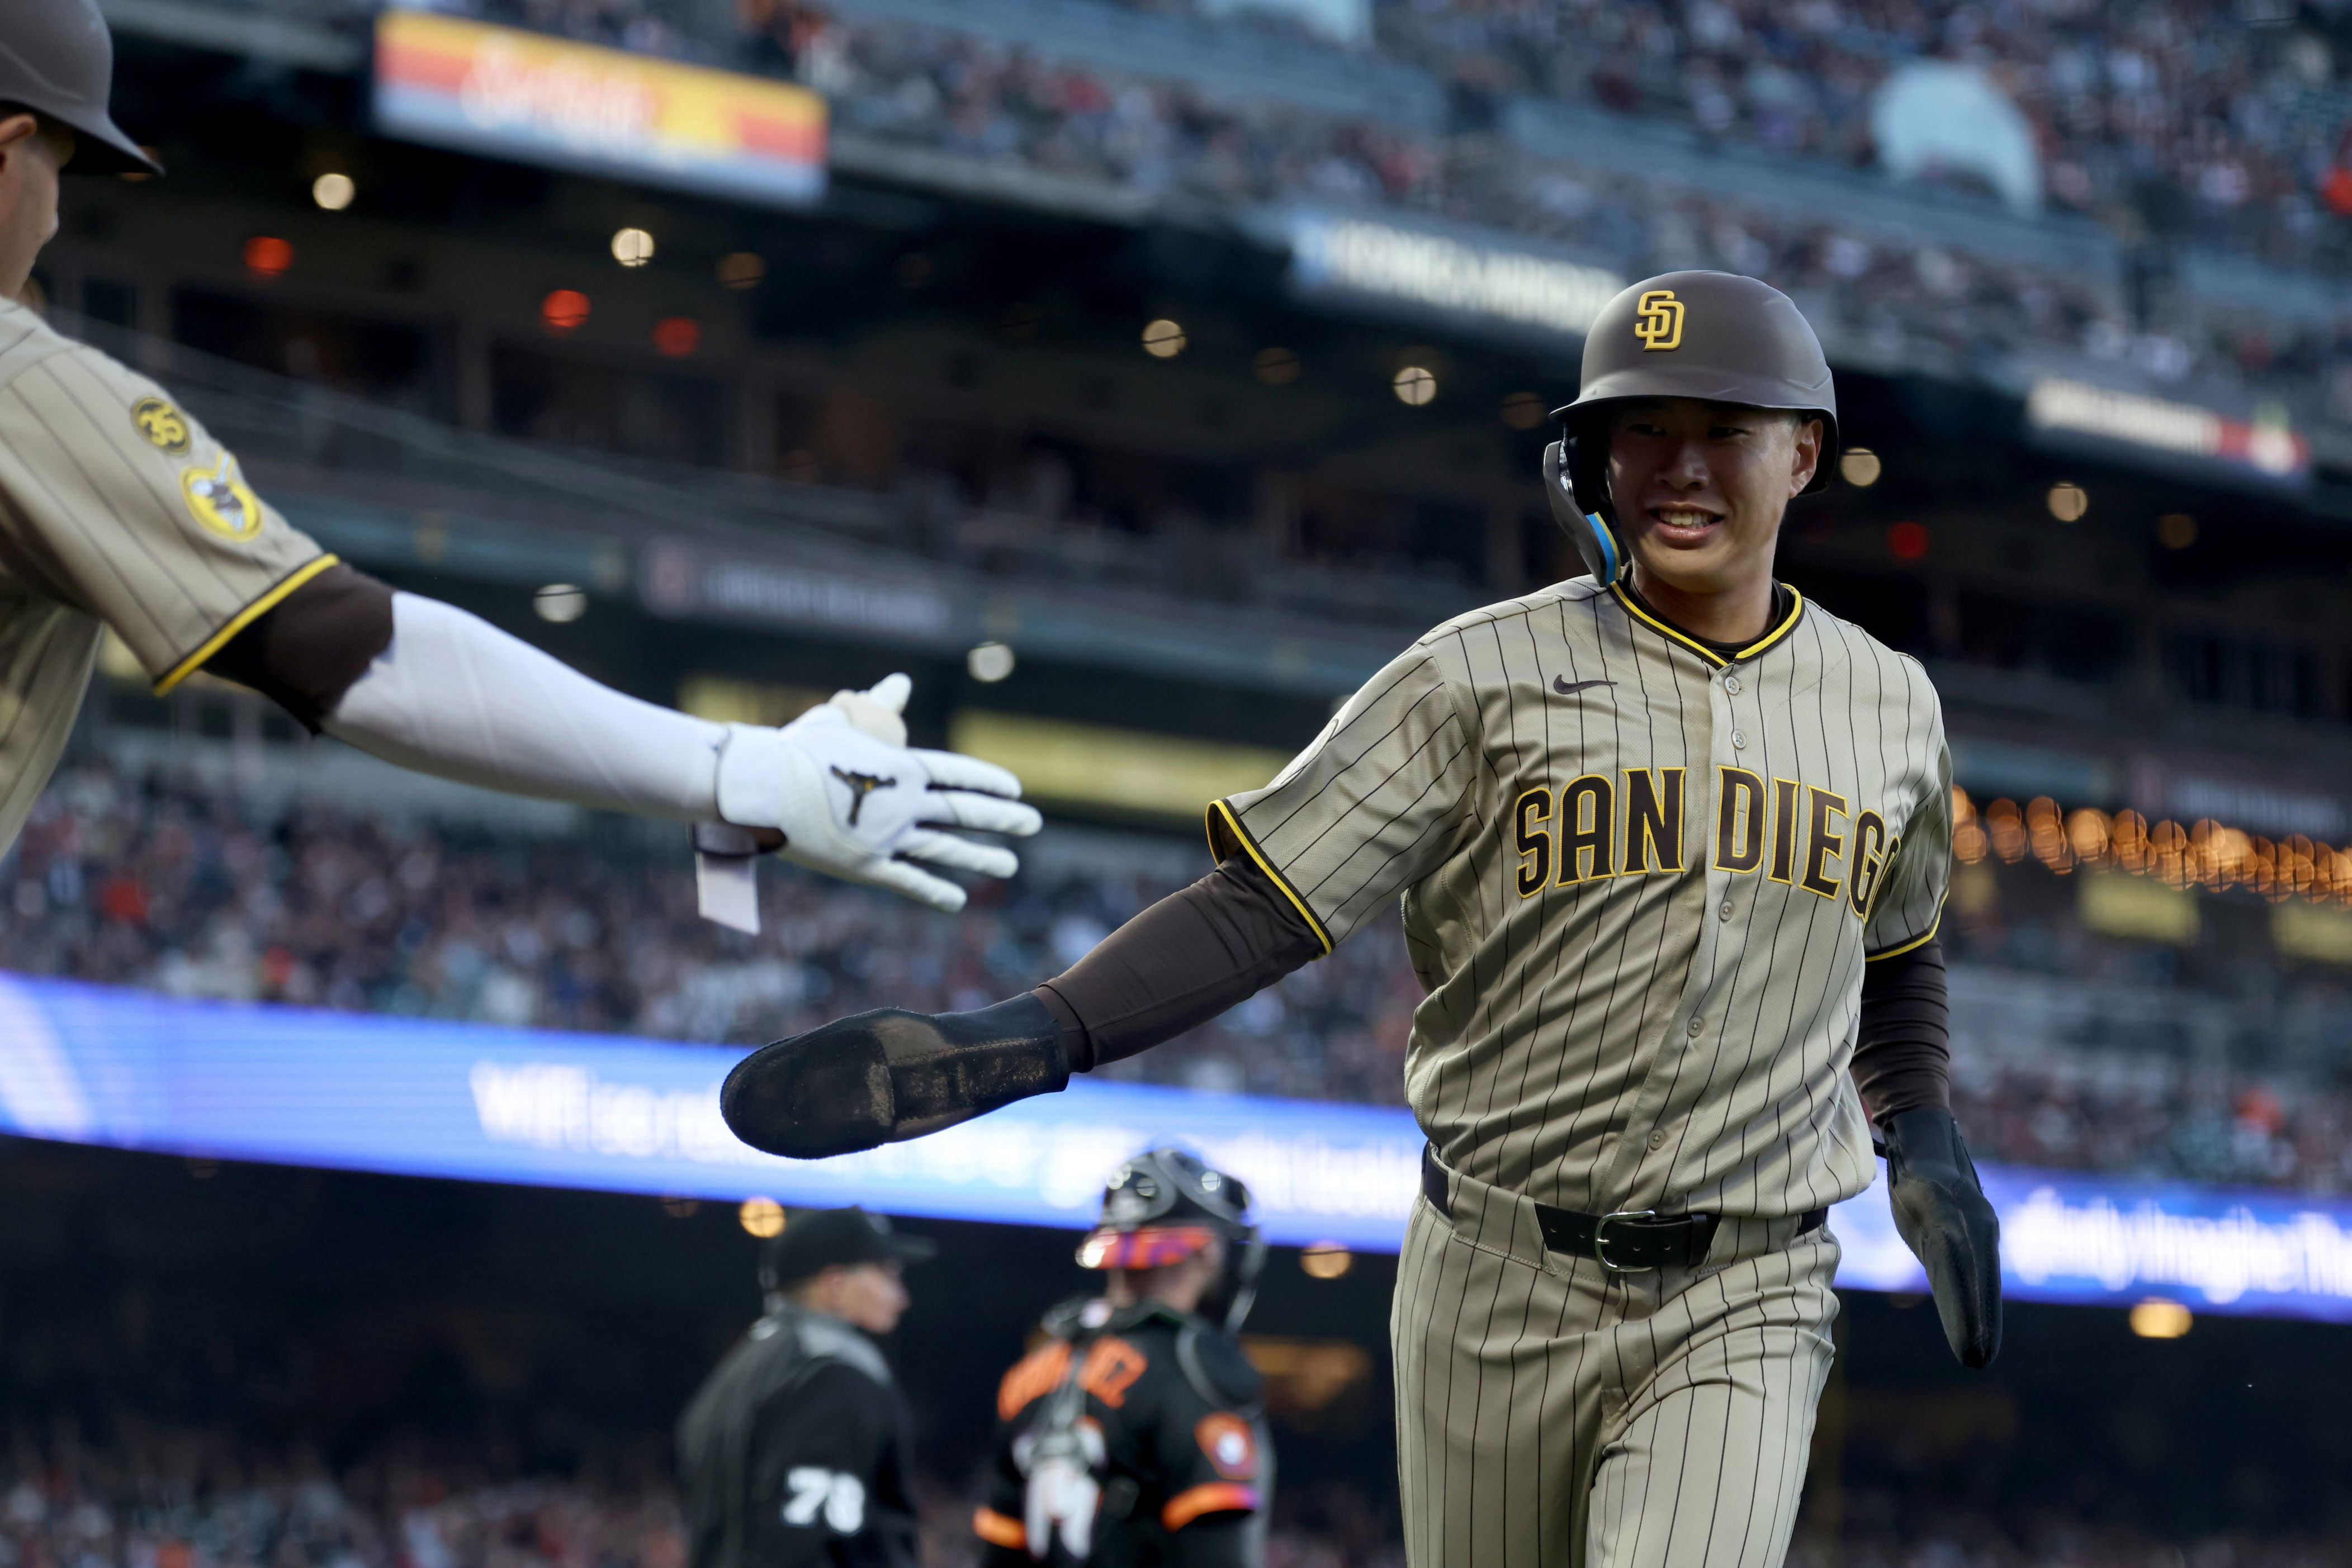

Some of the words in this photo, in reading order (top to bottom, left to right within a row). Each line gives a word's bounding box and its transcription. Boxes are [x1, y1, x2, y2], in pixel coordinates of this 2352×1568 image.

[1634, 290, 1685, 350] SD
[139, 402, 186, 447] 35
[1515, 766, 1686, 899] SAN
